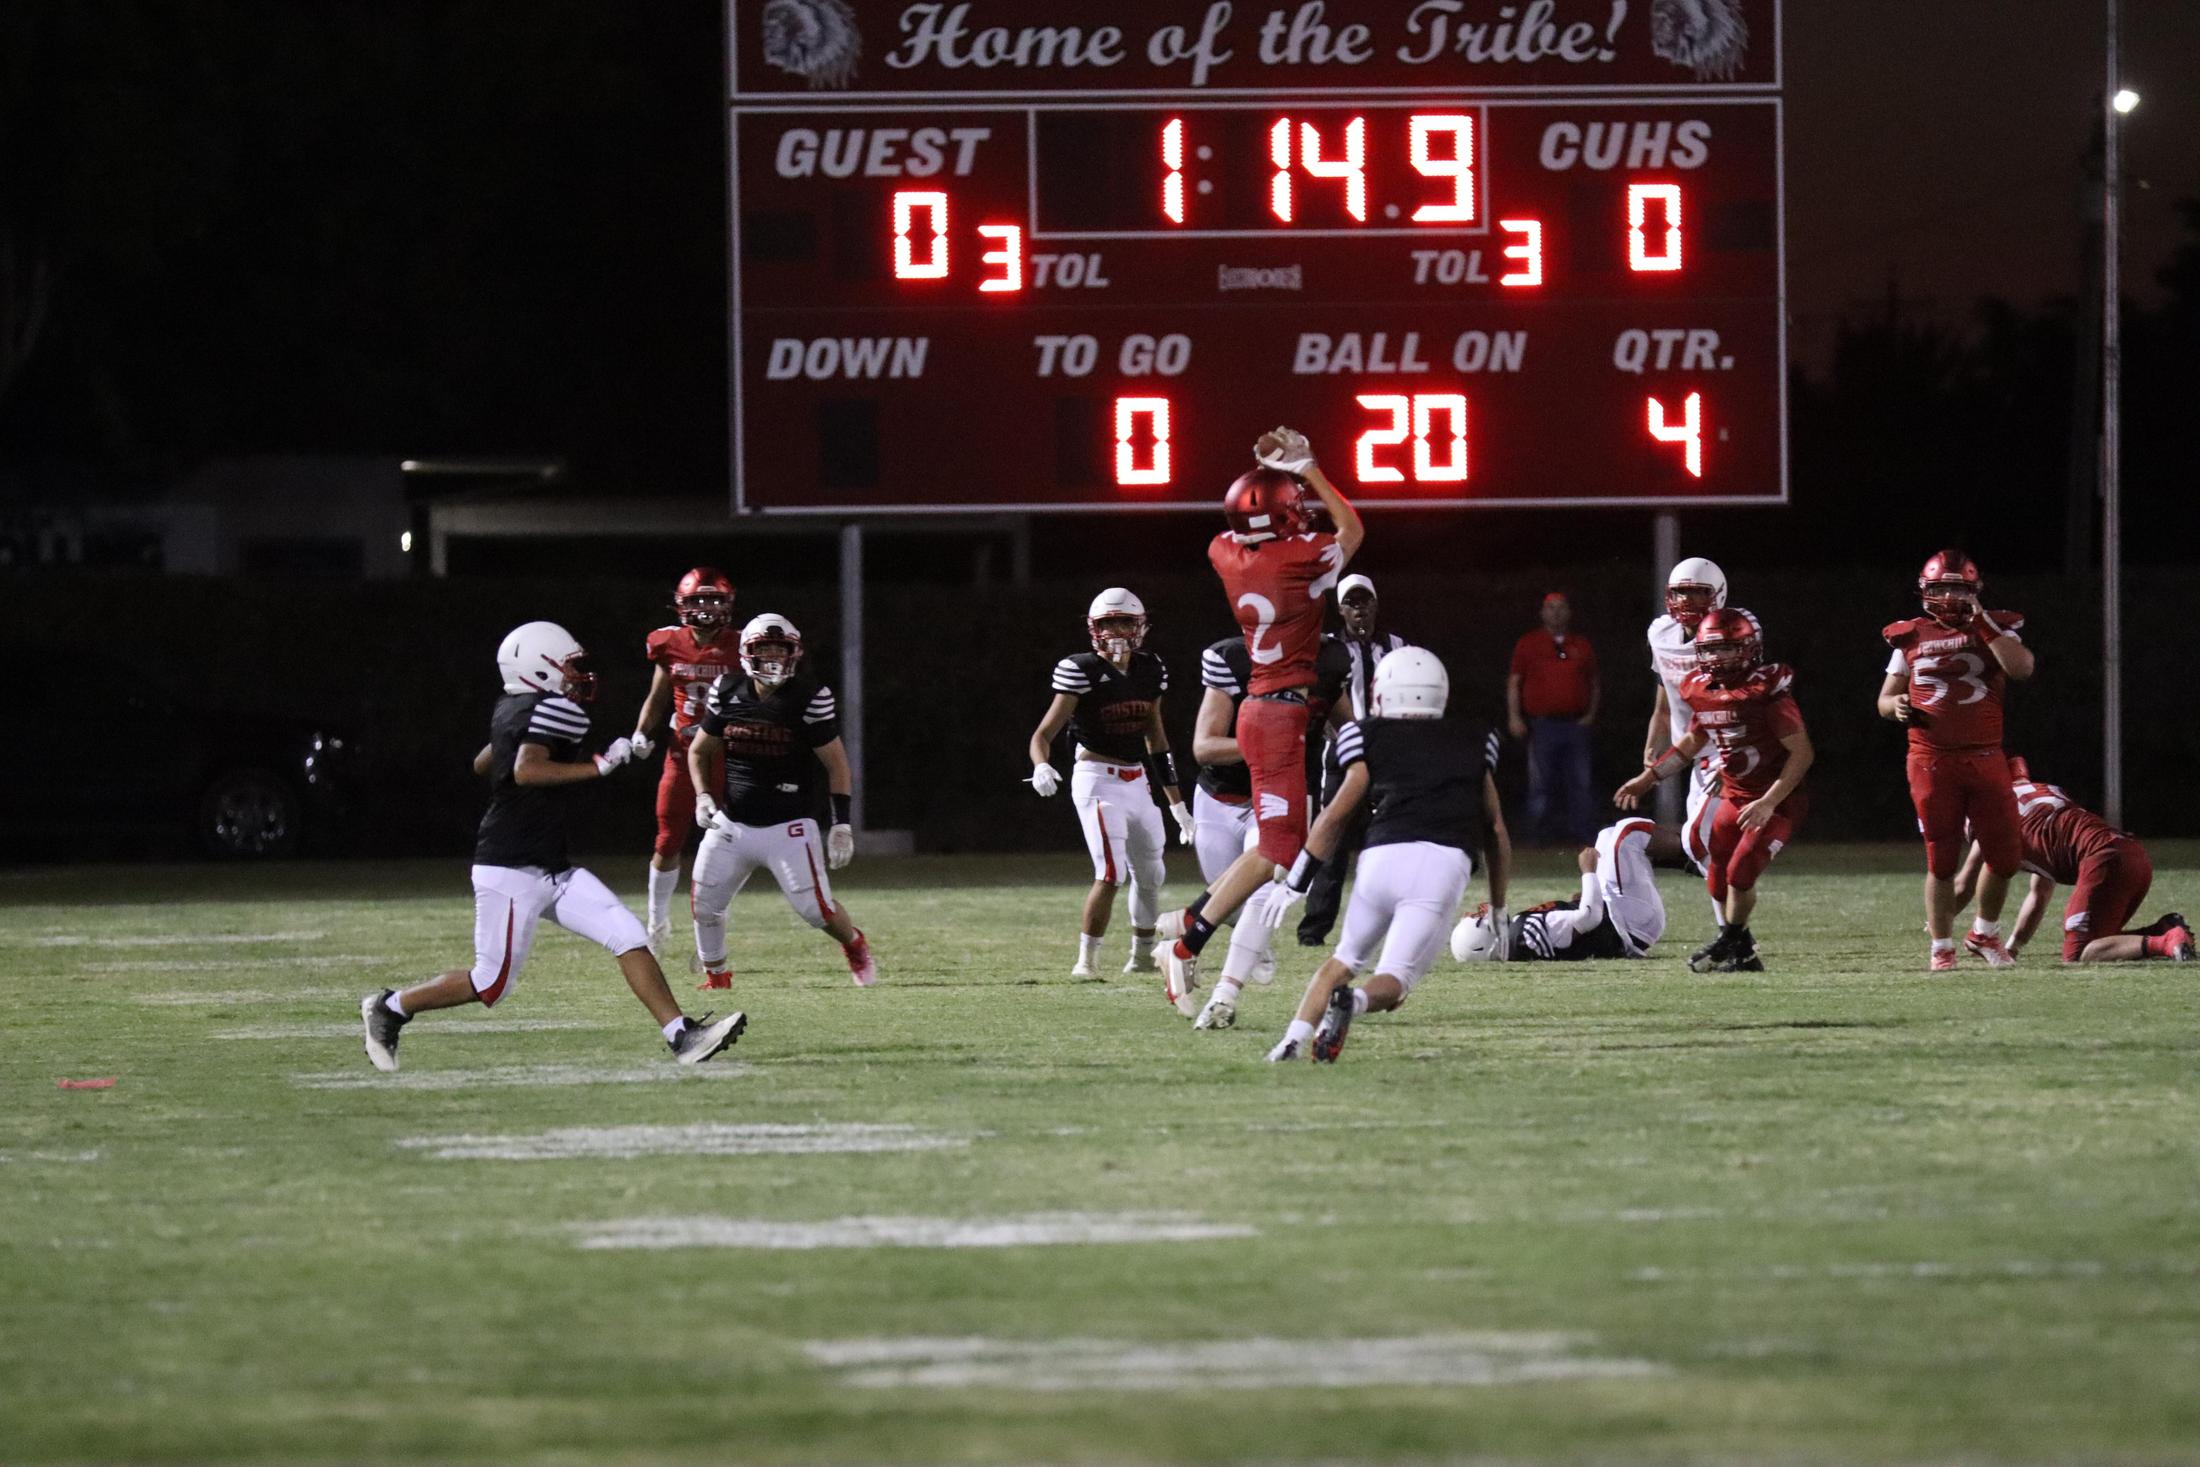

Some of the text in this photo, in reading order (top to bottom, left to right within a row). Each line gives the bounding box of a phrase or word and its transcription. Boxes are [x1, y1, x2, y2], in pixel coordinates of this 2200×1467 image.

[884, 0, 1627, 87] Home of the Tribe!
[775, 127, 991, 178] GUEST
[1539, 120, 1712, 170] CUHS
[893, 190, 949, 279] 0
[1499, 219, 1543, 287] 3
[1627, 183, 1682, 272] 0
[977, 224, 1022, 292] 3
[1031, 253, 1109, 288] TOL
[1411, 250, 1489, 284] TOL
[766, 337, 929, 380] DOWN
[1033, 334, 1192, 377] TO GO
[1292, 331, 1528, 375] BALL ON
[1613, 329, 1735, 375] QTR.
[1115, 397, 1171, 485] 0
[1355, 393, 1468, 482] 20
[1647, 391, 1702, 478] 4
[1237, 592, 1285, 665] 2
[1913, 653, 1988, 705] 53
[787, 822, 805, 838] G
